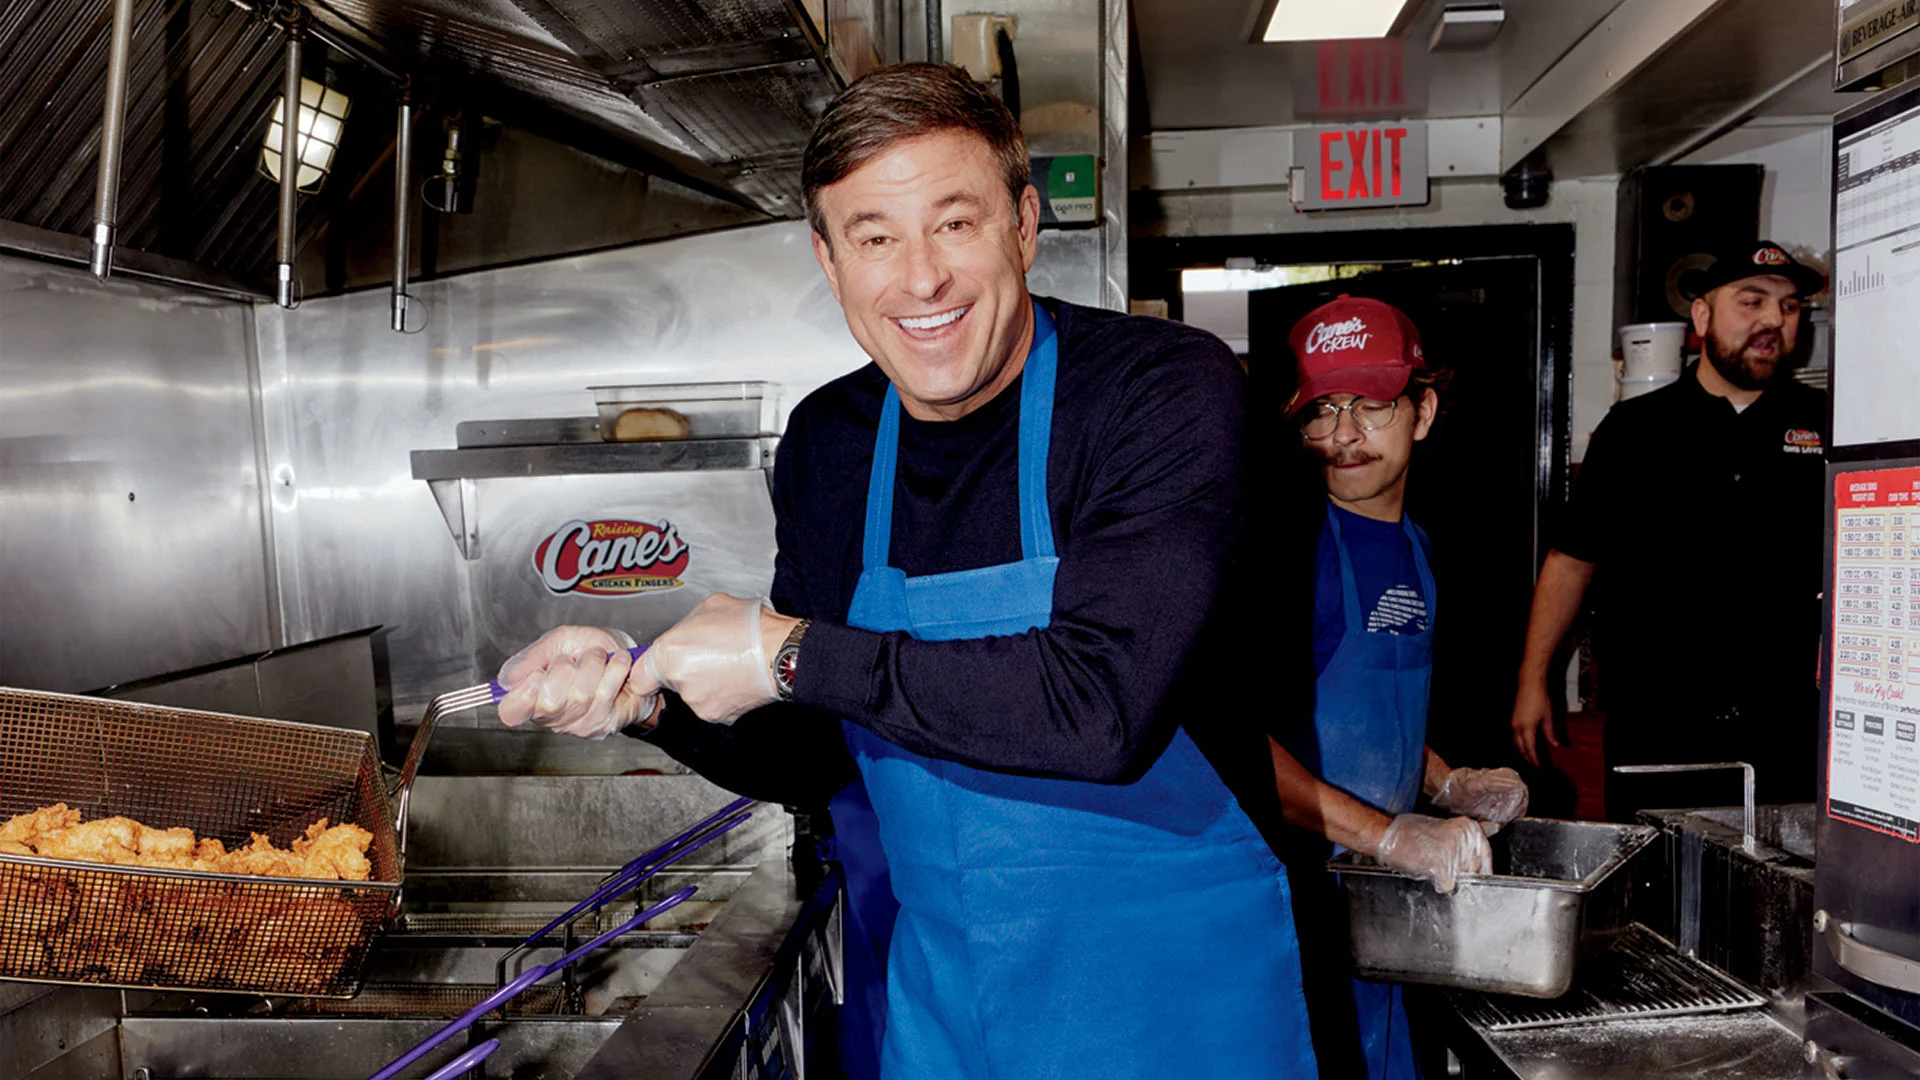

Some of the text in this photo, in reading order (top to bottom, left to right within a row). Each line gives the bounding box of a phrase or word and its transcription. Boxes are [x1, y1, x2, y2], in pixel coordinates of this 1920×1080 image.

[1320, 128, 1407, 200] EXIT
[1305, 316, 1367, 354] Cane's
[1321, 333, 1369, 354] CREW
[593, 522, 644, 538] Raising
[543, 519, 689, 592] Cane's
[592, 577, 675, 588] CHICKEN FINGERS
